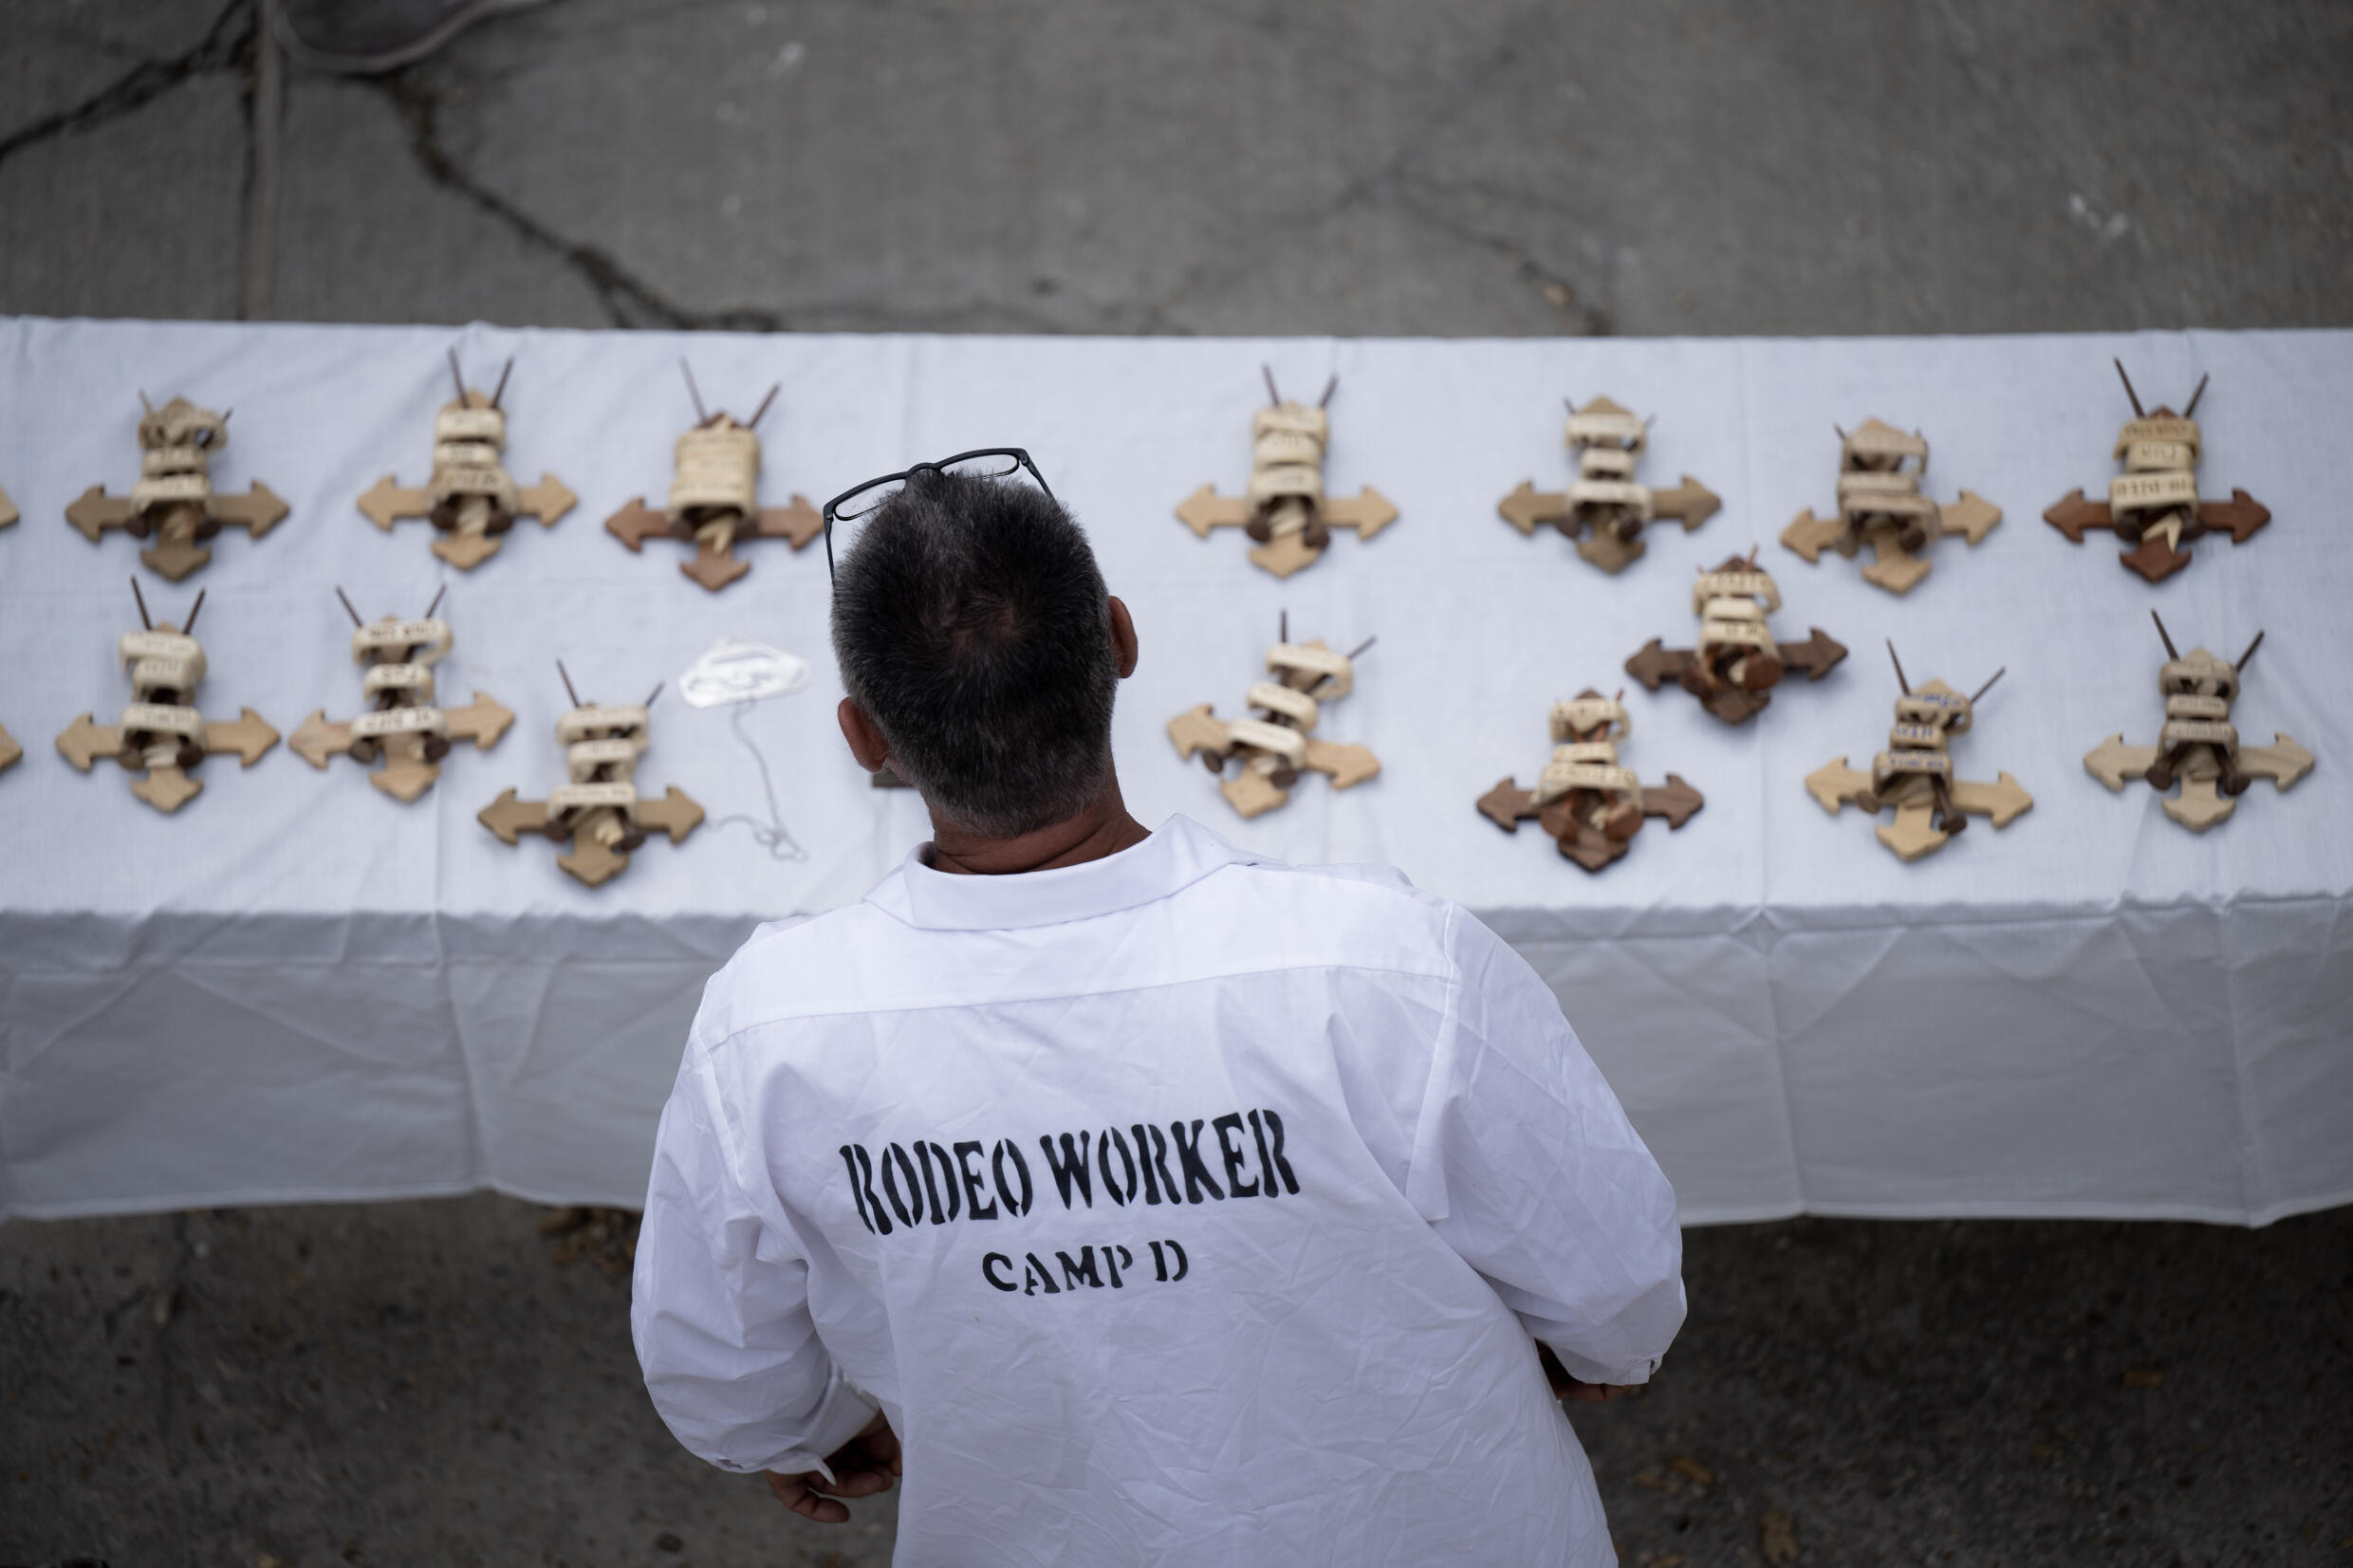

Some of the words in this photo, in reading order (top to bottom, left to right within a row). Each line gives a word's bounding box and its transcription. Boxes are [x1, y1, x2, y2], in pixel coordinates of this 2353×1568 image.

[839, 1138, 1033, 1236] RODEO
[1039, 1108, 1301, 1210] WORKER
[982, 1245, 1134, 1297] CAMP
[1147, 1239, 1189, 1282] D
